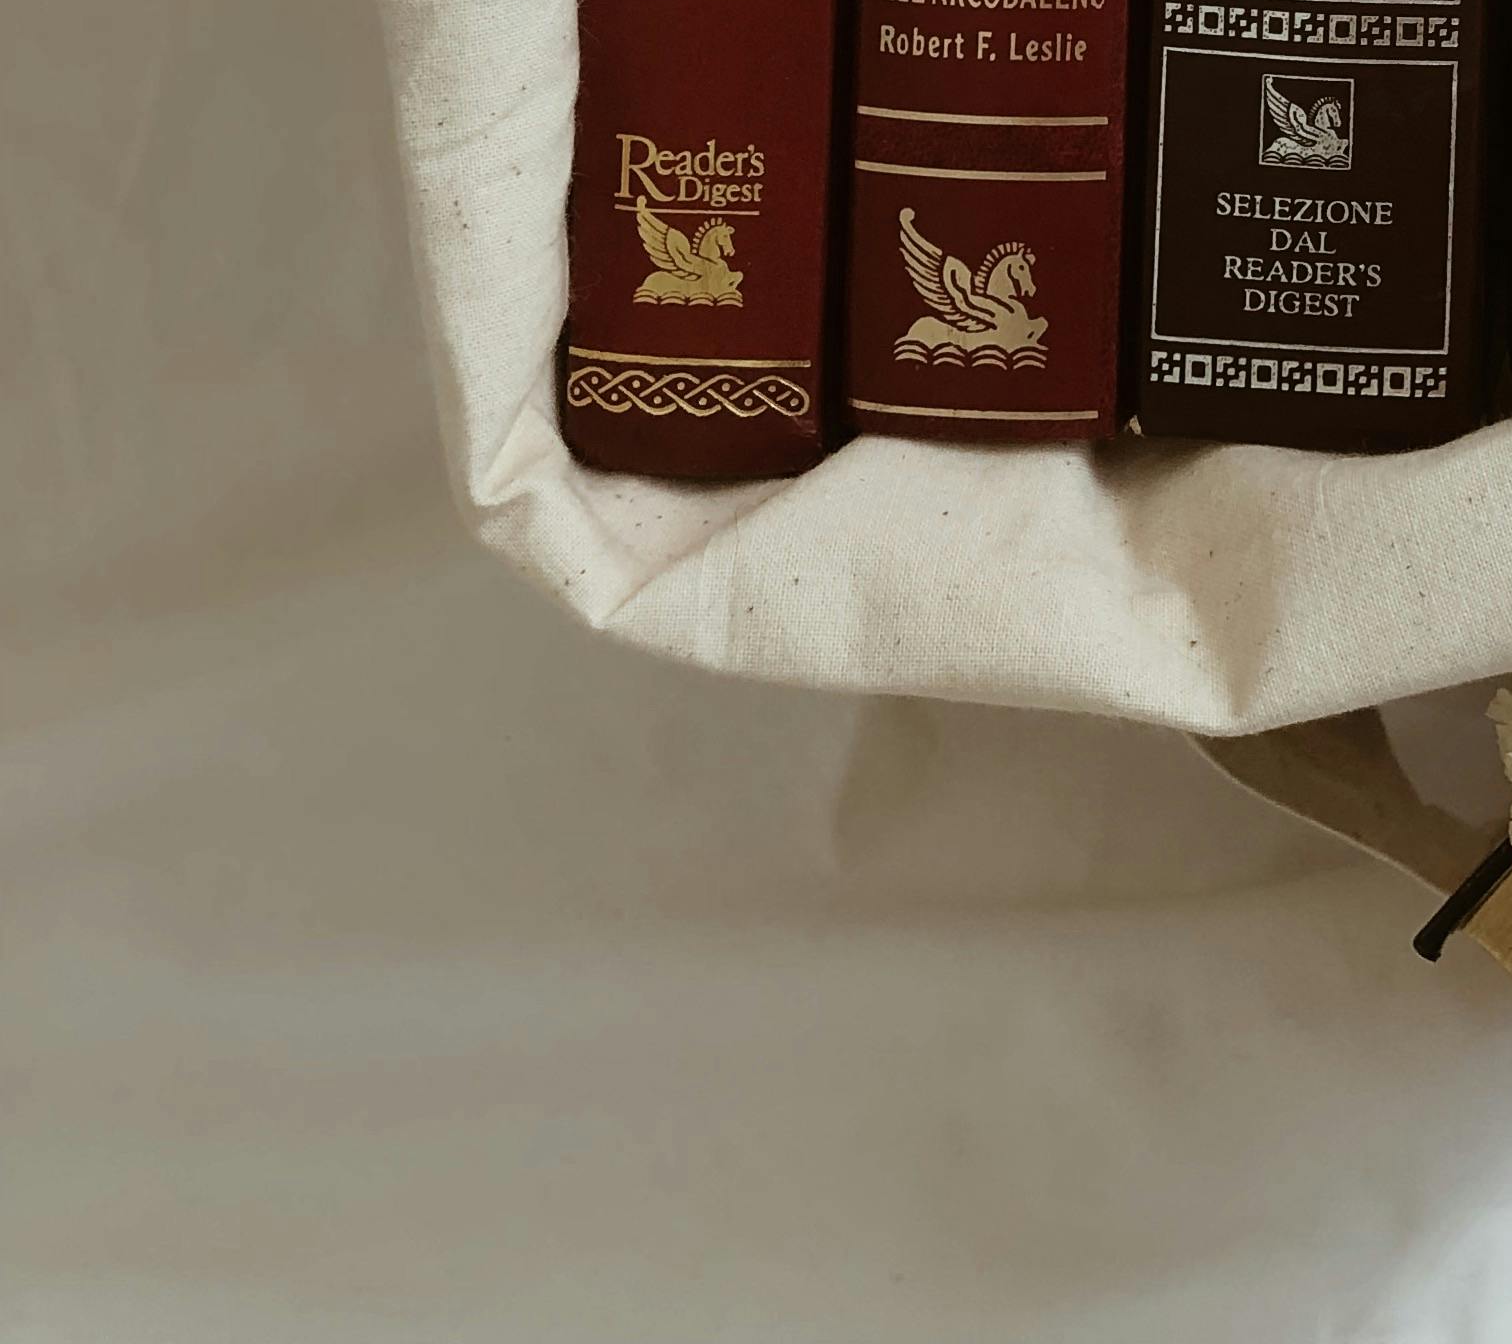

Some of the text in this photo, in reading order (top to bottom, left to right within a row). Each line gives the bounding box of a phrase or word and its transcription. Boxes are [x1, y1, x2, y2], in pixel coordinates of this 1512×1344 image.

[880, 25, 1086, 61] Robert F. Leslie
[614, 134, 764, 202] Reader's
[677, 176, 763, 207] Digest
[1217, 193, 1392, 224] SELEZIONE
[1270, 229, 1336, 254] DAL
[1224, 256, 1381, 286] READER'S
[1244, 289, 1359, 317] DIGEST
